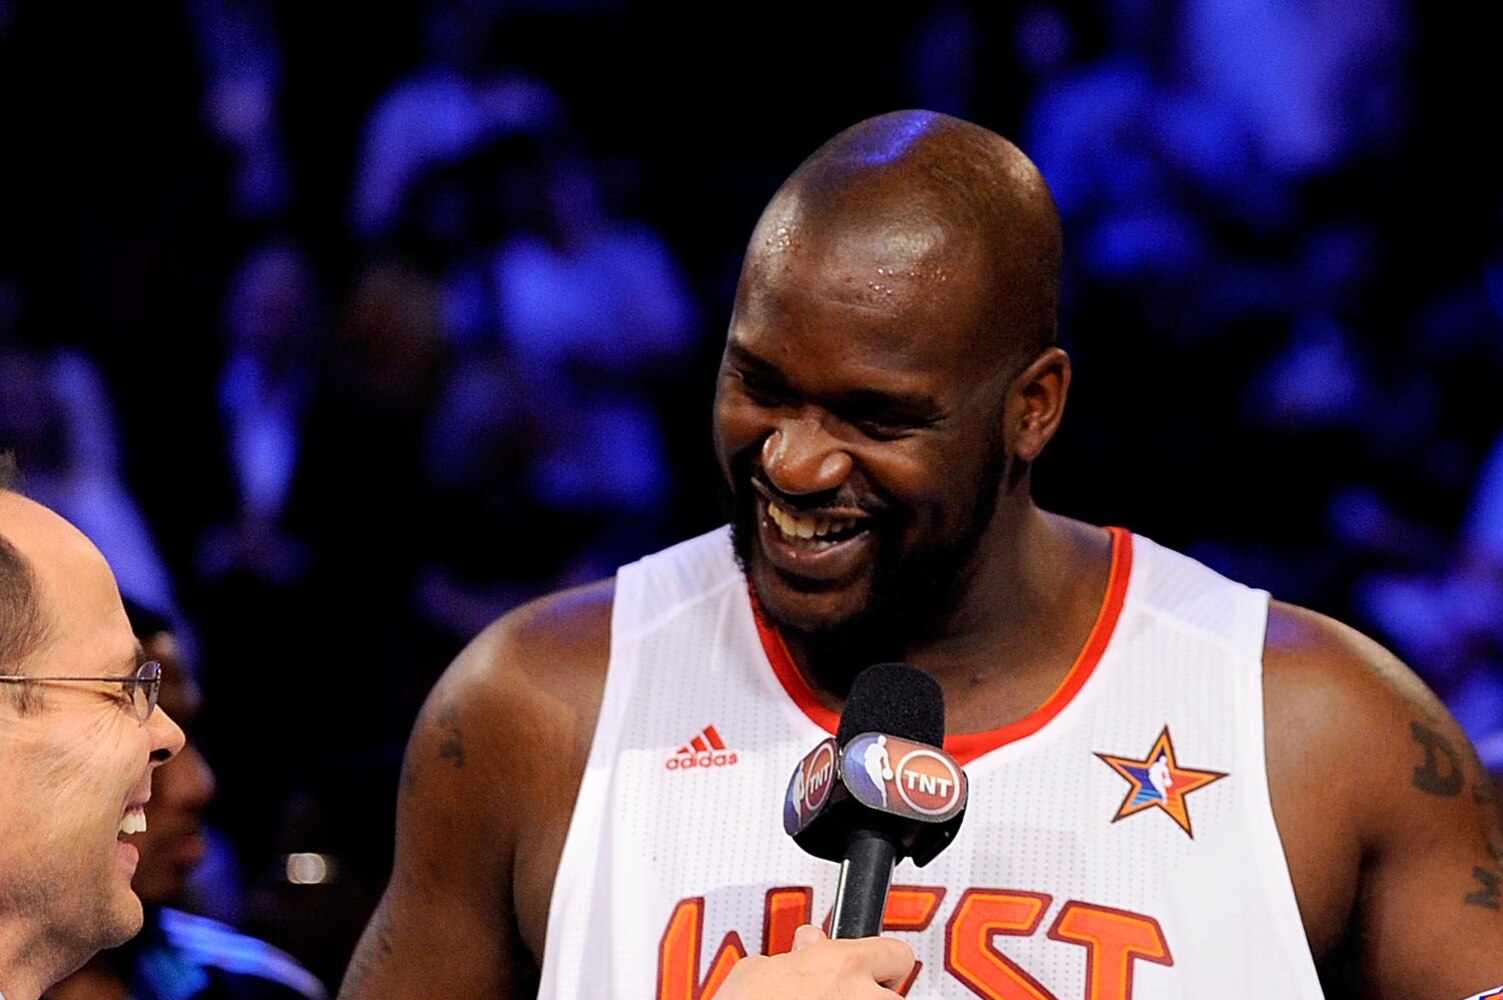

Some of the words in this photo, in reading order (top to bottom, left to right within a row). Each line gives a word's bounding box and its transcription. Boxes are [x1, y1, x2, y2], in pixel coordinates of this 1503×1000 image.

[666, 751, 738, 771] adidas
[809, 762, 831, 795] TNT
[903, 769, 952, 798] TNT
